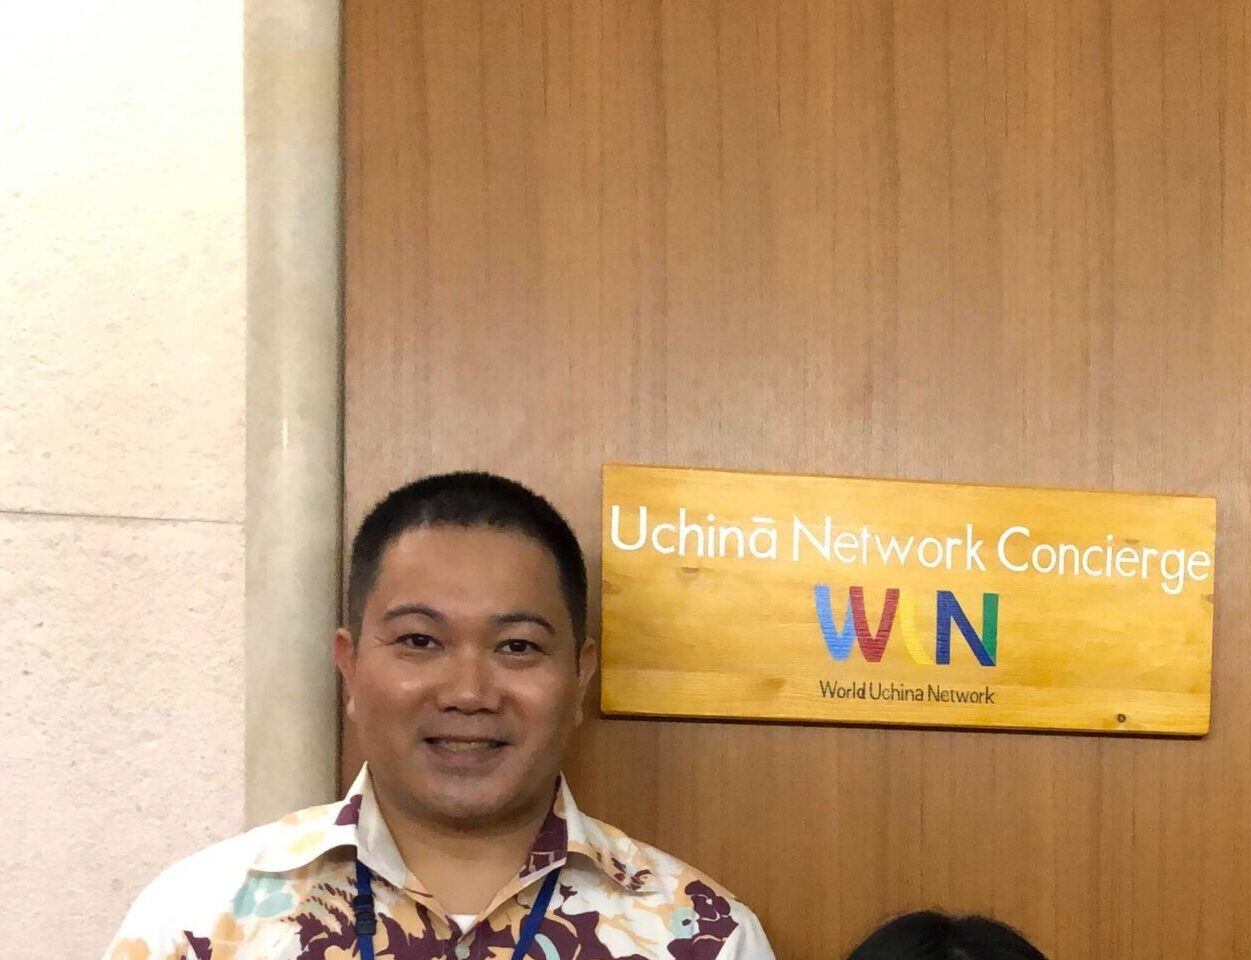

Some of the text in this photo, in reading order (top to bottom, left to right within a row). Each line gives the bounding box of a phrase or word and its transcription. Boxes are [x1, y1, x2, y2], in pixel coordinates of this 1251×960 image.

[792, 513, 987, 572] Network
[997, 525, 1212, 595] Concierge
[819, 679, 996, 704] World Uchina Network
